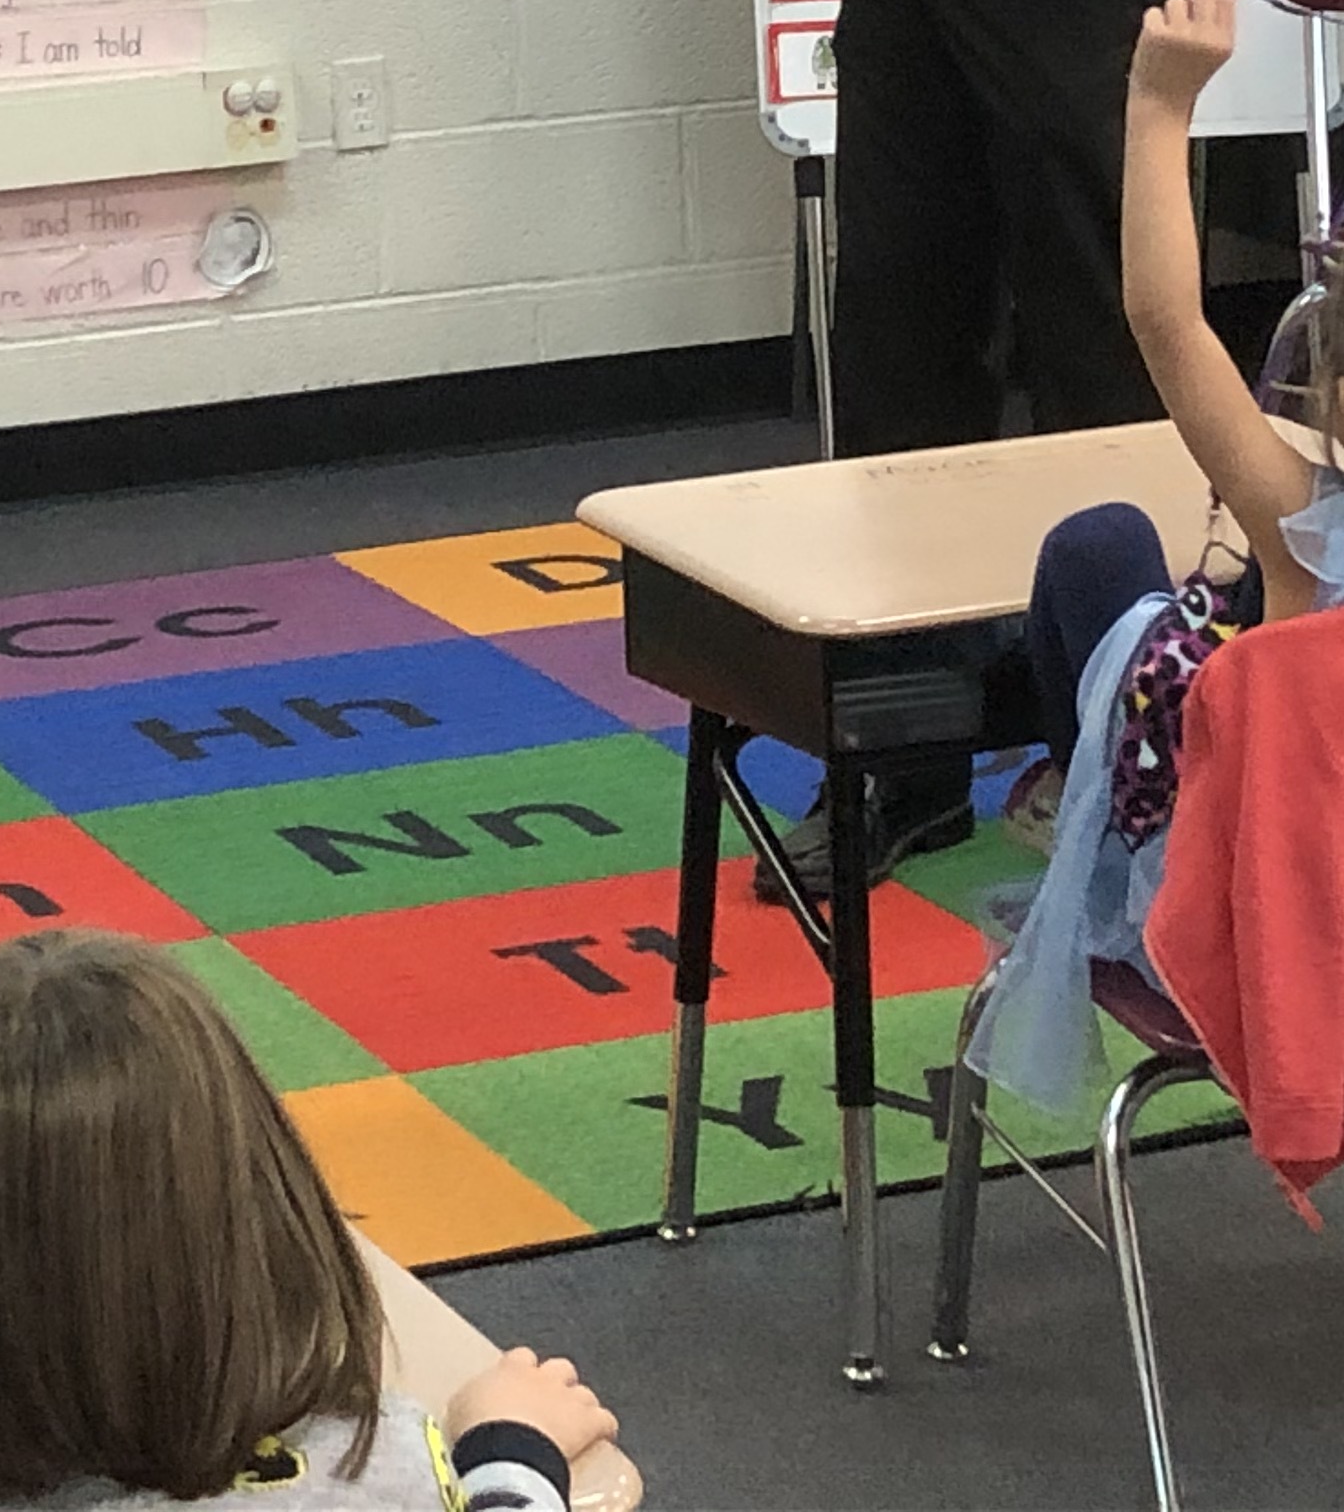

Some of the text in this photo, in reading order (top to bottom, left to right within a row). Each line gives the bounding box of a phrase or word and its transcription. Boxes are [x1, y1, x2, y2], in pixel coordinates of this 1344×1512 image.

[16, 31, 33, 65] I
[44, 42, 79, 64] am
[94, 26, 143, 58] told
[21, 199, 70, 239] and
[87, 194, 141, 232] thin
[43, 273, 112, 307] worth
[142, 257, 169, 295] 10
[131, 696, 443, 763] Hh
[275, 803, 623, 876] Nn
